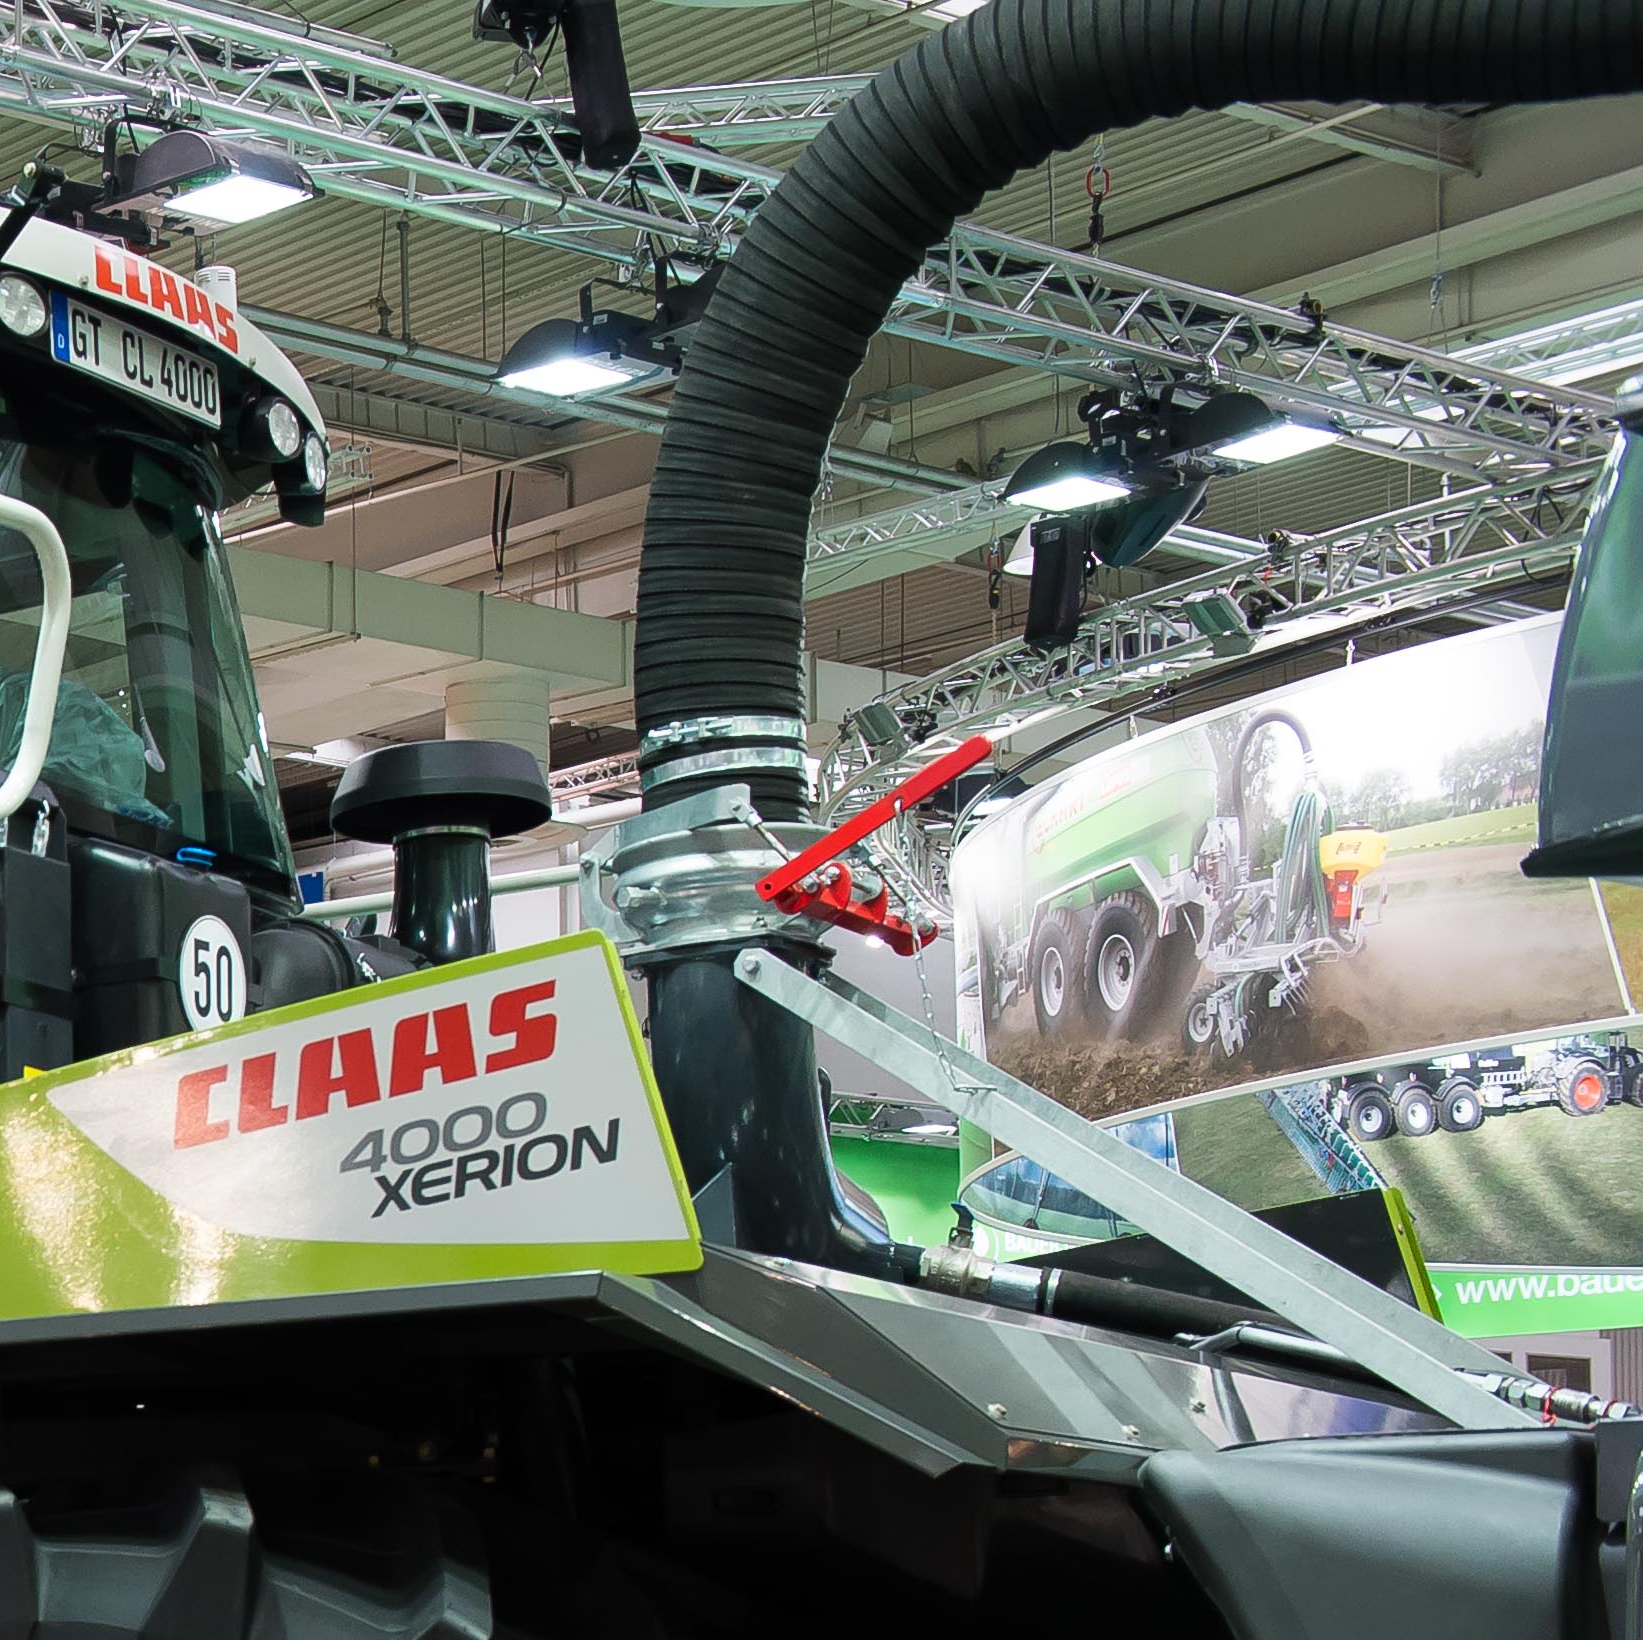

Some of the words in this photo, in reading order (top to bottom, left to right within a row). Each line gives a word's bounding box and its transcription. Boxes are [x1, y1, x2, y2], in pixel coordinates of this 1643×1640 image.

[71, 307, 101, 366] GT
[122, 329, 153, 389] CL
[160, 347, 217, 416] 4000
[194, 937, 233, 1022] 50
[173, 979, 557, 1150] CLAAS
[339, 1092, 546, 1173] 4000
[371, 1117, 620, 1218] XERION
